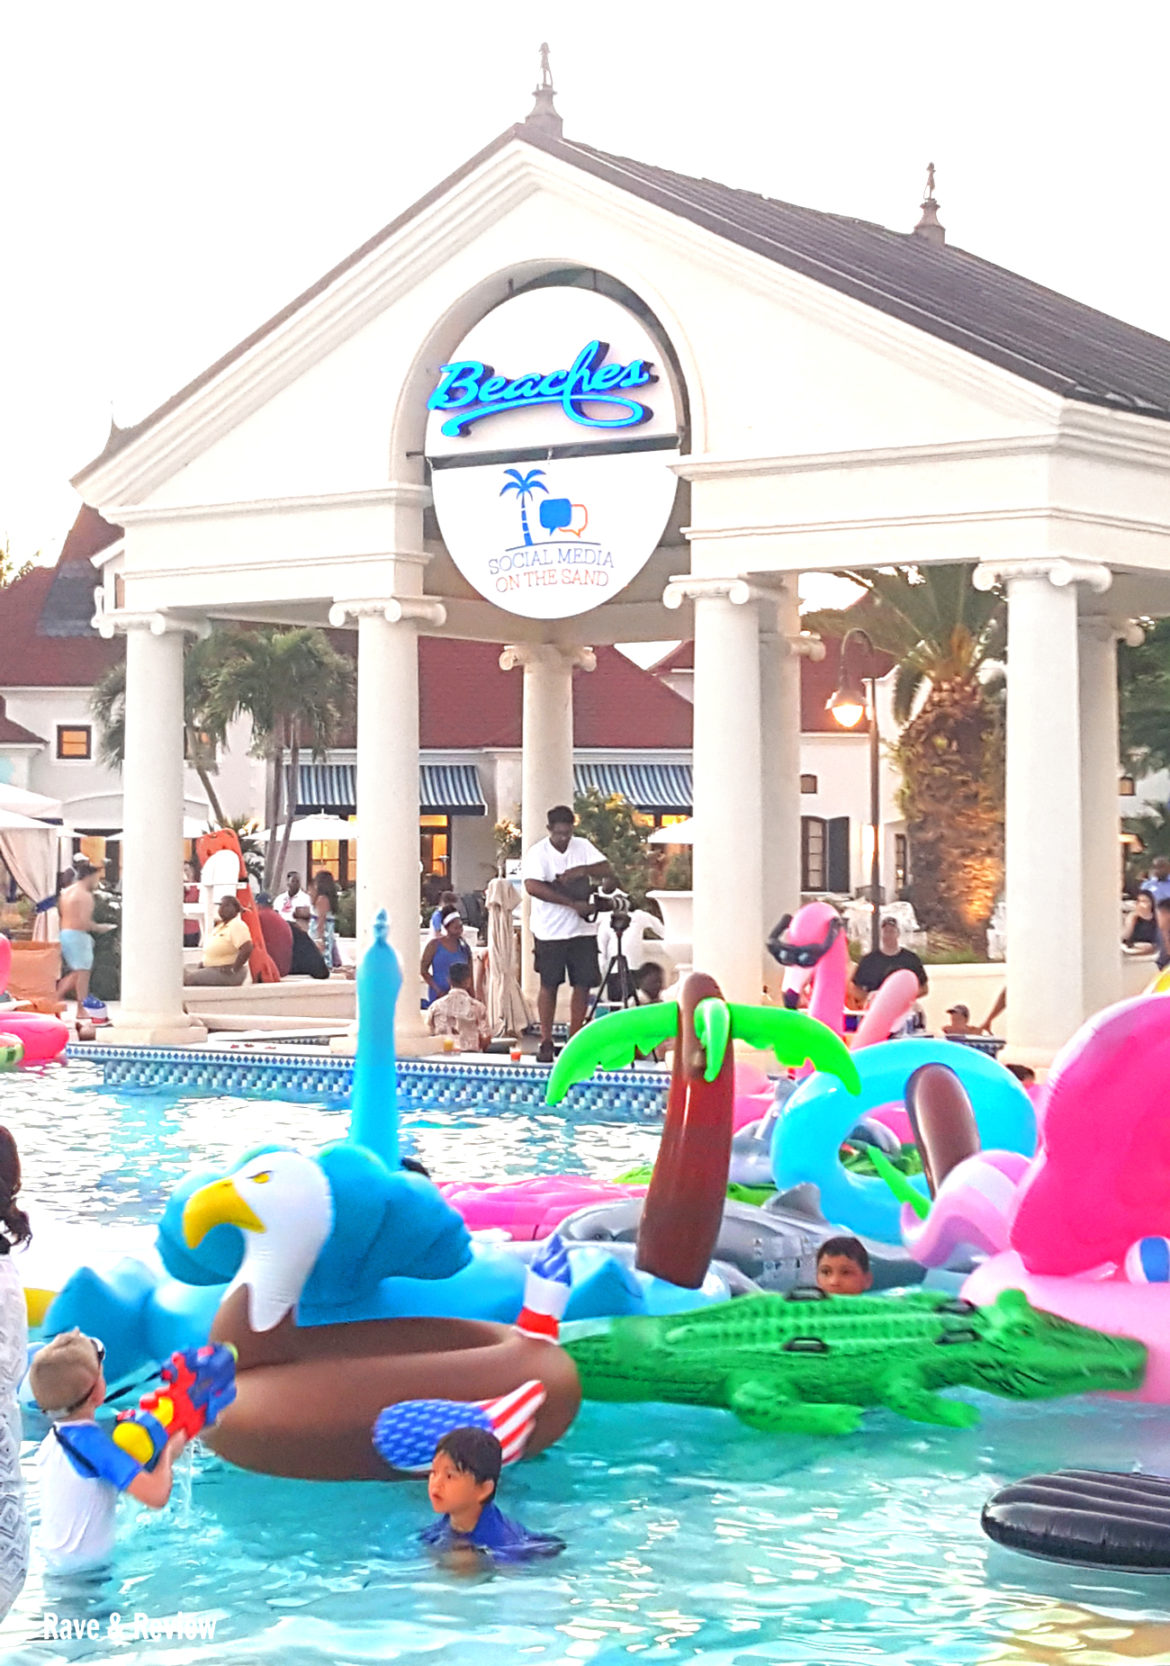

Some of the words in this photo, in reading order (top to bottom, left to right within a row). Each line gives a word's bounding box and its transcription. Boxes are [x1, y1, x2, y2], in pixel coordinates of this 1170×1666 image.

[427, 340, 652, 437] Beaches
[488, 549, 553, 575] SOCIAL
[557, 548, 614, 568] MEDIA
[495, 574, 520, 593] ON
[523, 569, 558, 587] THE
[561, 568, 609, 587] SAND
